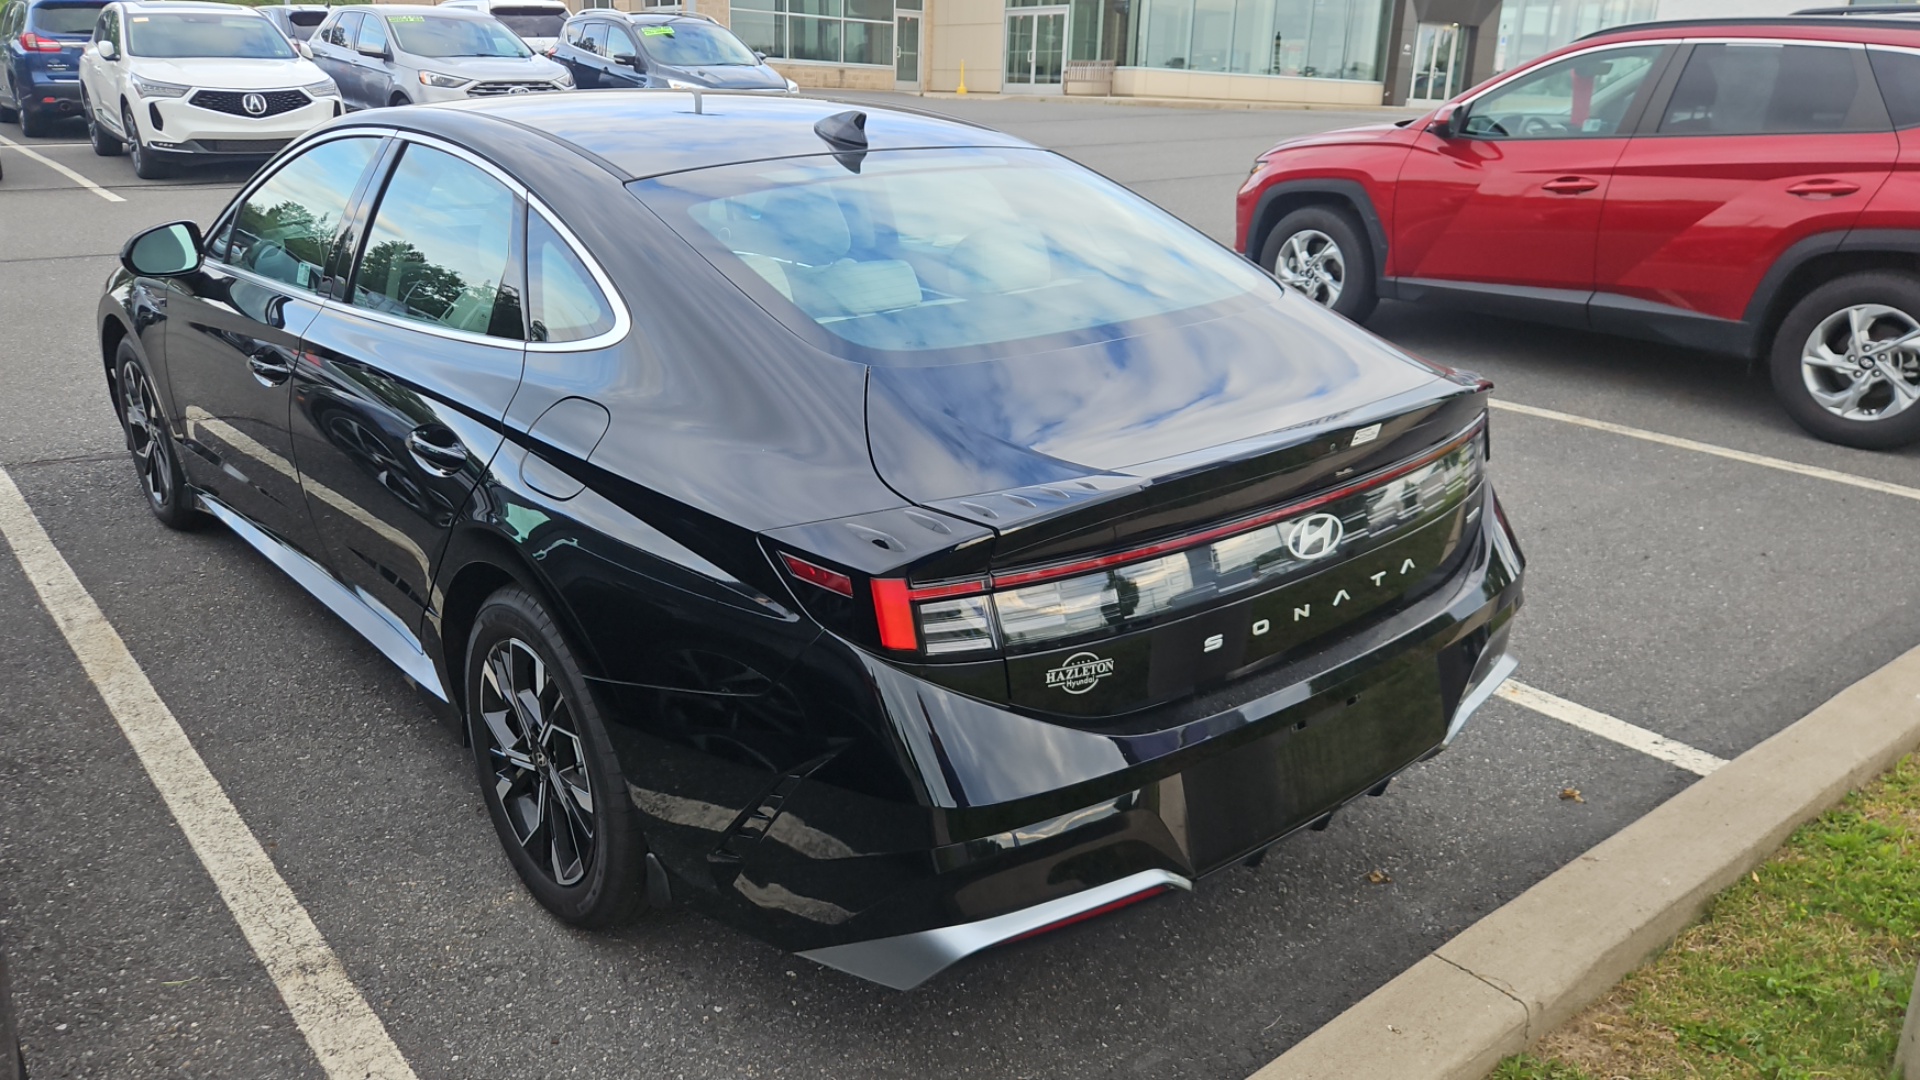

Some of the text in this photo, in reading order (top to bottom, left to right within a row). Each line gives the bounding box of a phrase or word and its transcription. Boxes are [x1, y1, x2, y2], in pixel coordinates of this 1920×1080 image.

[1204, 558, 1415, 652] SONATA
[1046, 661, 1114, 683] HAZLETON
[1066, 675, 1095, 688] Hyundai
